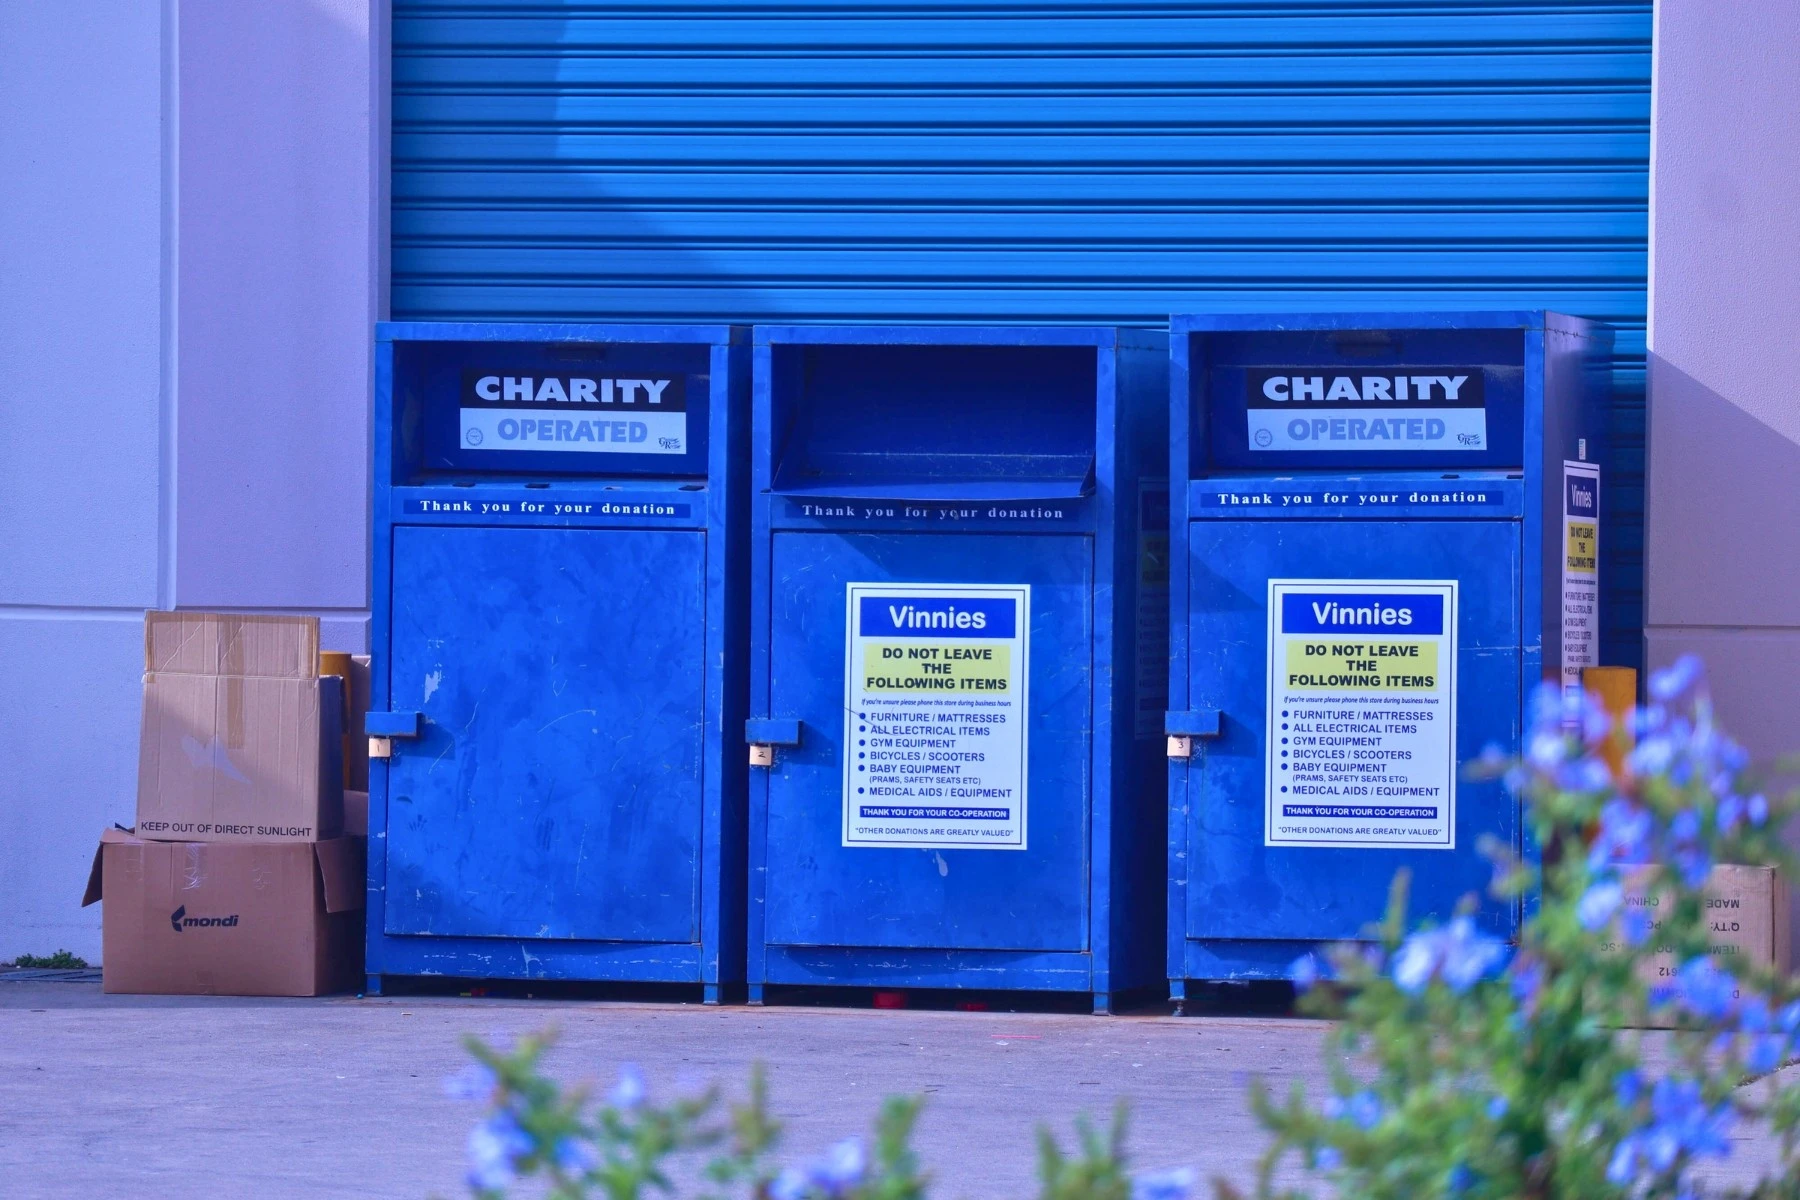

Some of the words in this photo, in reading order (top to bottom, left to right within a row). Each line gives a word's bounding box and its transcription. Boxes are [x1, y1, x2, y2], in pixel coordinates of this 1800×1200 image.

[475, 376, 671, 404] CHARITY
[1263, 376, 1468, 401] CHARITY
[498, 418, 648, 443] OPERATED
[1287, 418, 1445, 440] OPERATED
[1218, 493, 1272, 504] Thank
[1282, 495, 1312, 506] you
[1323, 493, 1348, 503] for
[1359, 494, 1399, 505] your
[1409, 492, 1487, 502] donation
[1572, 484, 1591, 508] Vinnies
[420, 500, 472, 512] Thank
[482, 502, 511, 513] you
[521, 501, 544, 512] for
[555, 504, 592, 514] your
[602, 502, 674, 514] donation
[802, 505, 855, 516] Thank
[866, 508, 894, 518] you
[905, 506, 928, 517] for
[940, 508, 978, 519] your
[988, 507, 1063, 518] donation
[889, 605, 986, 629] Vinnies
[1312, 602, 1412, 625] Vinnies
[883, 648, 903, 658] DO
[909, 648, 939, 659] NOT
[944, 649, 992, 660] LEAVE
[1306, 645, 1326, 655] DO
[1332, 645, 1364, 656] NOT
[1369, 646, 1418, 656] LEAVE
[922, 664, 951, 674] THE
[1346, 660, 1376, 671] THE
[867, 678, 955, 688] FOLLOWING
[961, 679, 1007, 689] ITEMS
[1290, 675, 1380, 686] FOLLOWING
[1386, 676, 1434, 686] ITEMS
[871, 713, 930, 722] FURNITURE
[938, 714, 1006, 723] MATTRESSES
[1294, 711, 1354, 720] FURNITURE
[1363, 712, 1433, 720] MATTRESSES
[871, 726, 890, 734] ALL
[893, 726, 956, 735] ELECTRICAL
[959, 727, 990, 735] ITEMS
[1293, 724, 1312, 732] ALL
[1316, 724, 1381, 733] ELECTRICAL
[1385, 725, 1416, 733] ITEMS
[871, 739, 892, 747] GYM
[896, 739, 956, 748] EQUIPMENT
[1294, 737, 1316, 746] GYM
[1320, 737, 1382, 746] EQUIPMENT
[870, 752, 920, 760] BICYCLES
[929, 753, 985, 761] SCOOTERS
[1293, 750, 1345, 758] BICYCLES
[1354, 751, 1412, 760] SCOOTERS
[870, 764, 897, 773] BABY
[900, 765, 960, 774] EQUIPMENT
[1293, 763, 1321, 771] BABY
[1324, 763, 1386, 772] EQUIPMENT
[870, 787, 915, 796] MEDICAL
[918, 788, 942, 796] AIDS
[951, 788, 1012, 798] EQUIPMENT
[1293, 786, 1340, 794] MEDICAL
[1343, 786, 1367, 795] AIDS
[1377, 787, 1439, 796] EQUIPMENT
[141, 822, 169, 831] KEEP
[172, 822, 195, 832] OUT
[197, 824, 212, 833] OF
[215, 824, 254, 835] DIRECT
[257, 825, 312, 837] SUNLIGHT
[1707, 900, 1739, 908] MADE
[183, 915, 239, 927] mondi
[1710, 922, 1740, 932] Q'TY:
